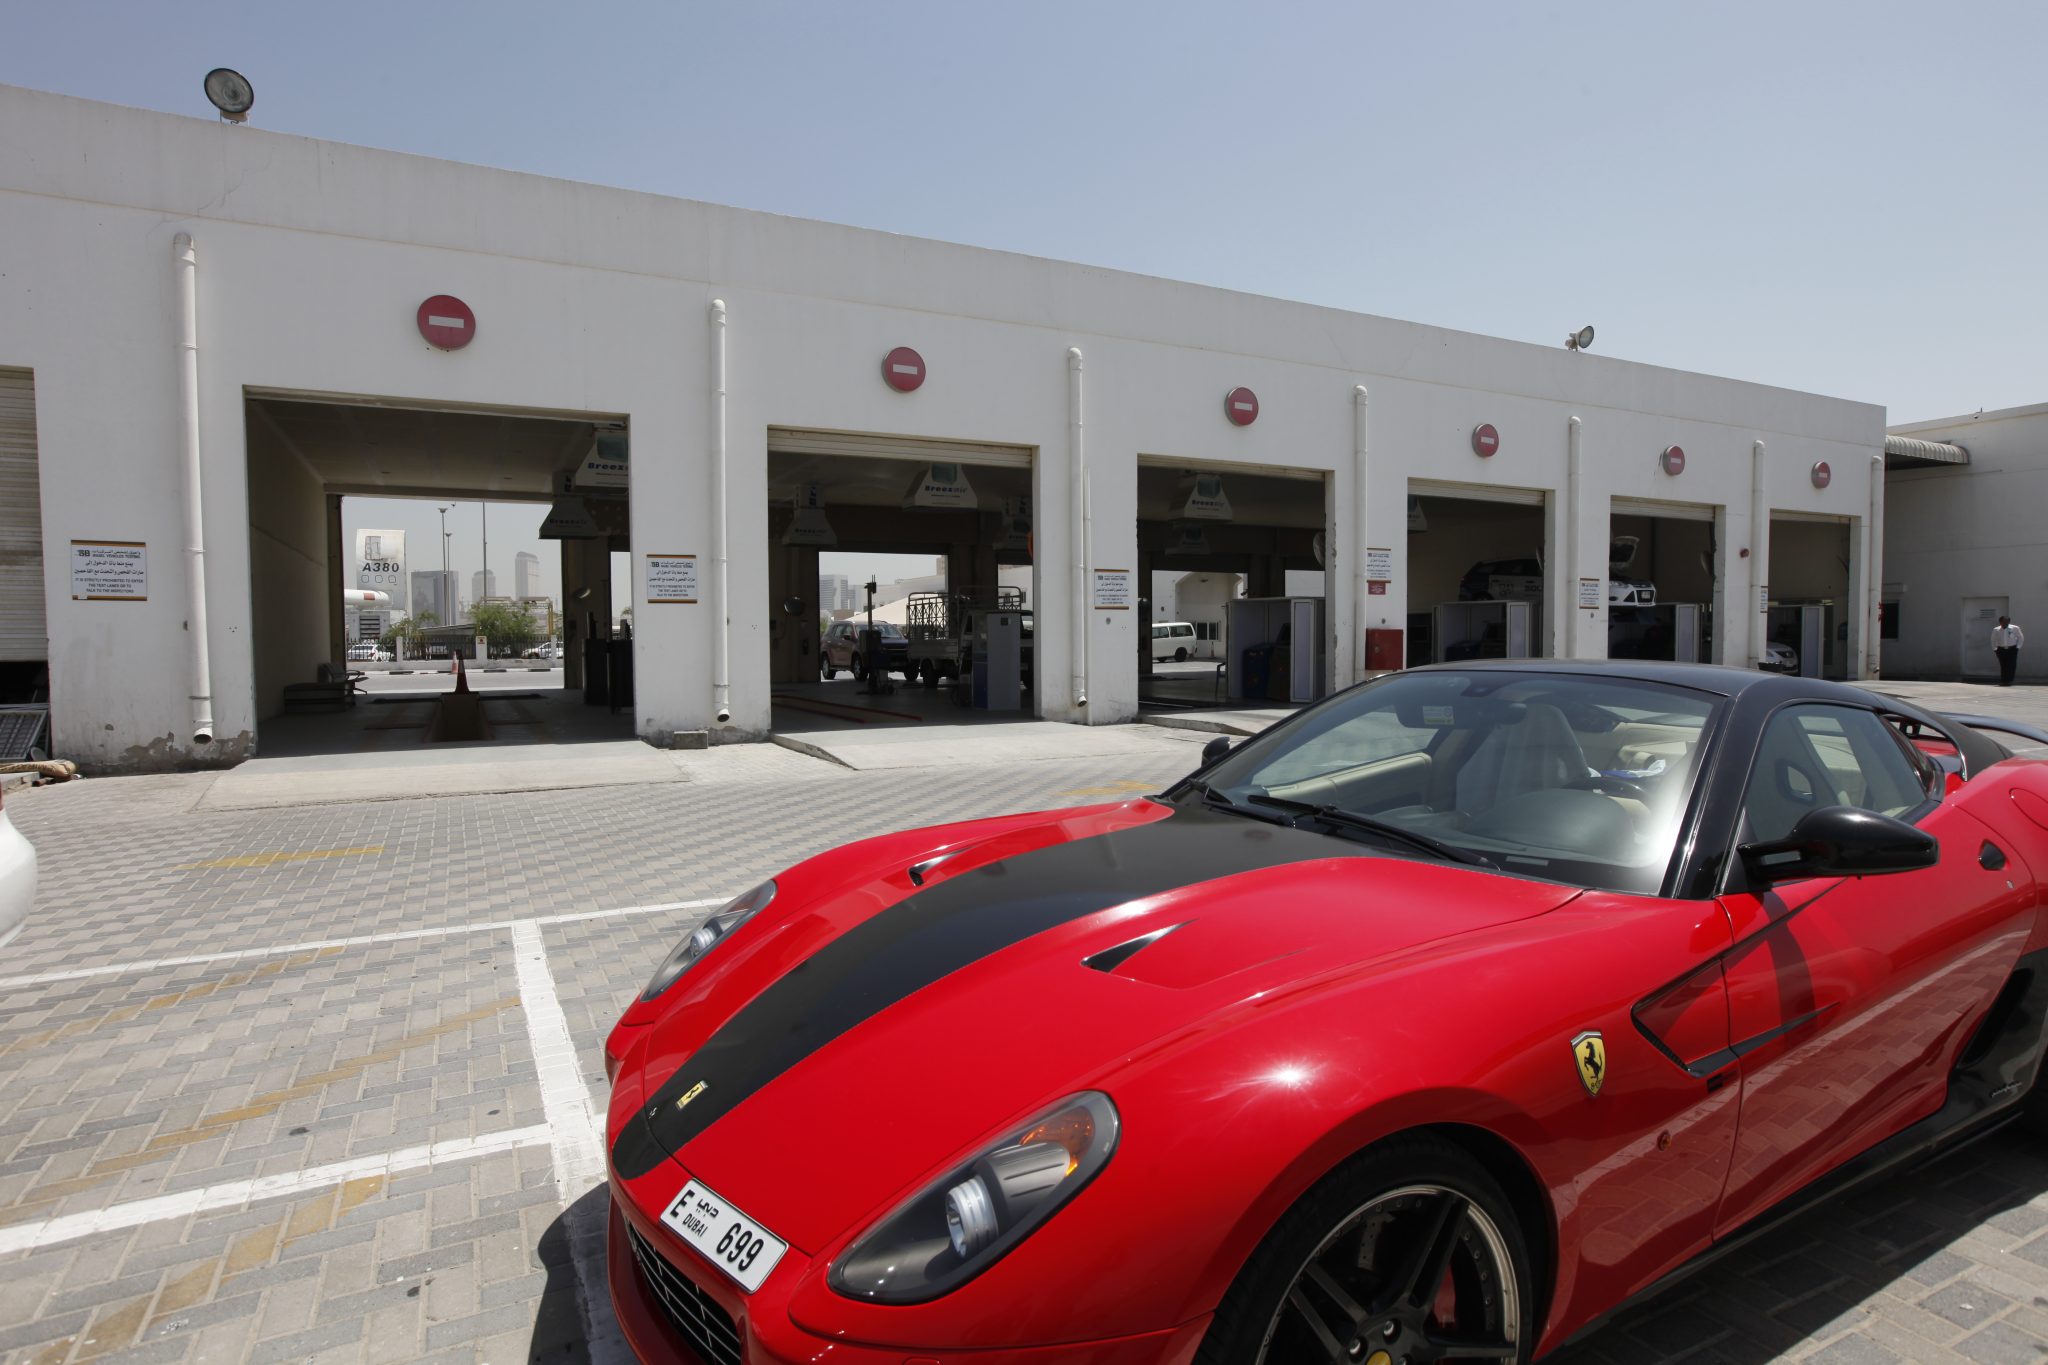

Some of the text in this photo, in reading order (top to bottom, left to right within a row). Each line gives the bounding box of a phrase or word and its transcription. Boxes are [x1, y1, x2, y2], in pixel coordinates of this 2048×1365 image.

[362, 562, 400, 572] A380
[670, 1189, 696, 1218] E
[682, 1213, 708, 1238] DUBAI
[716, 1222, 764, 1272] 699
